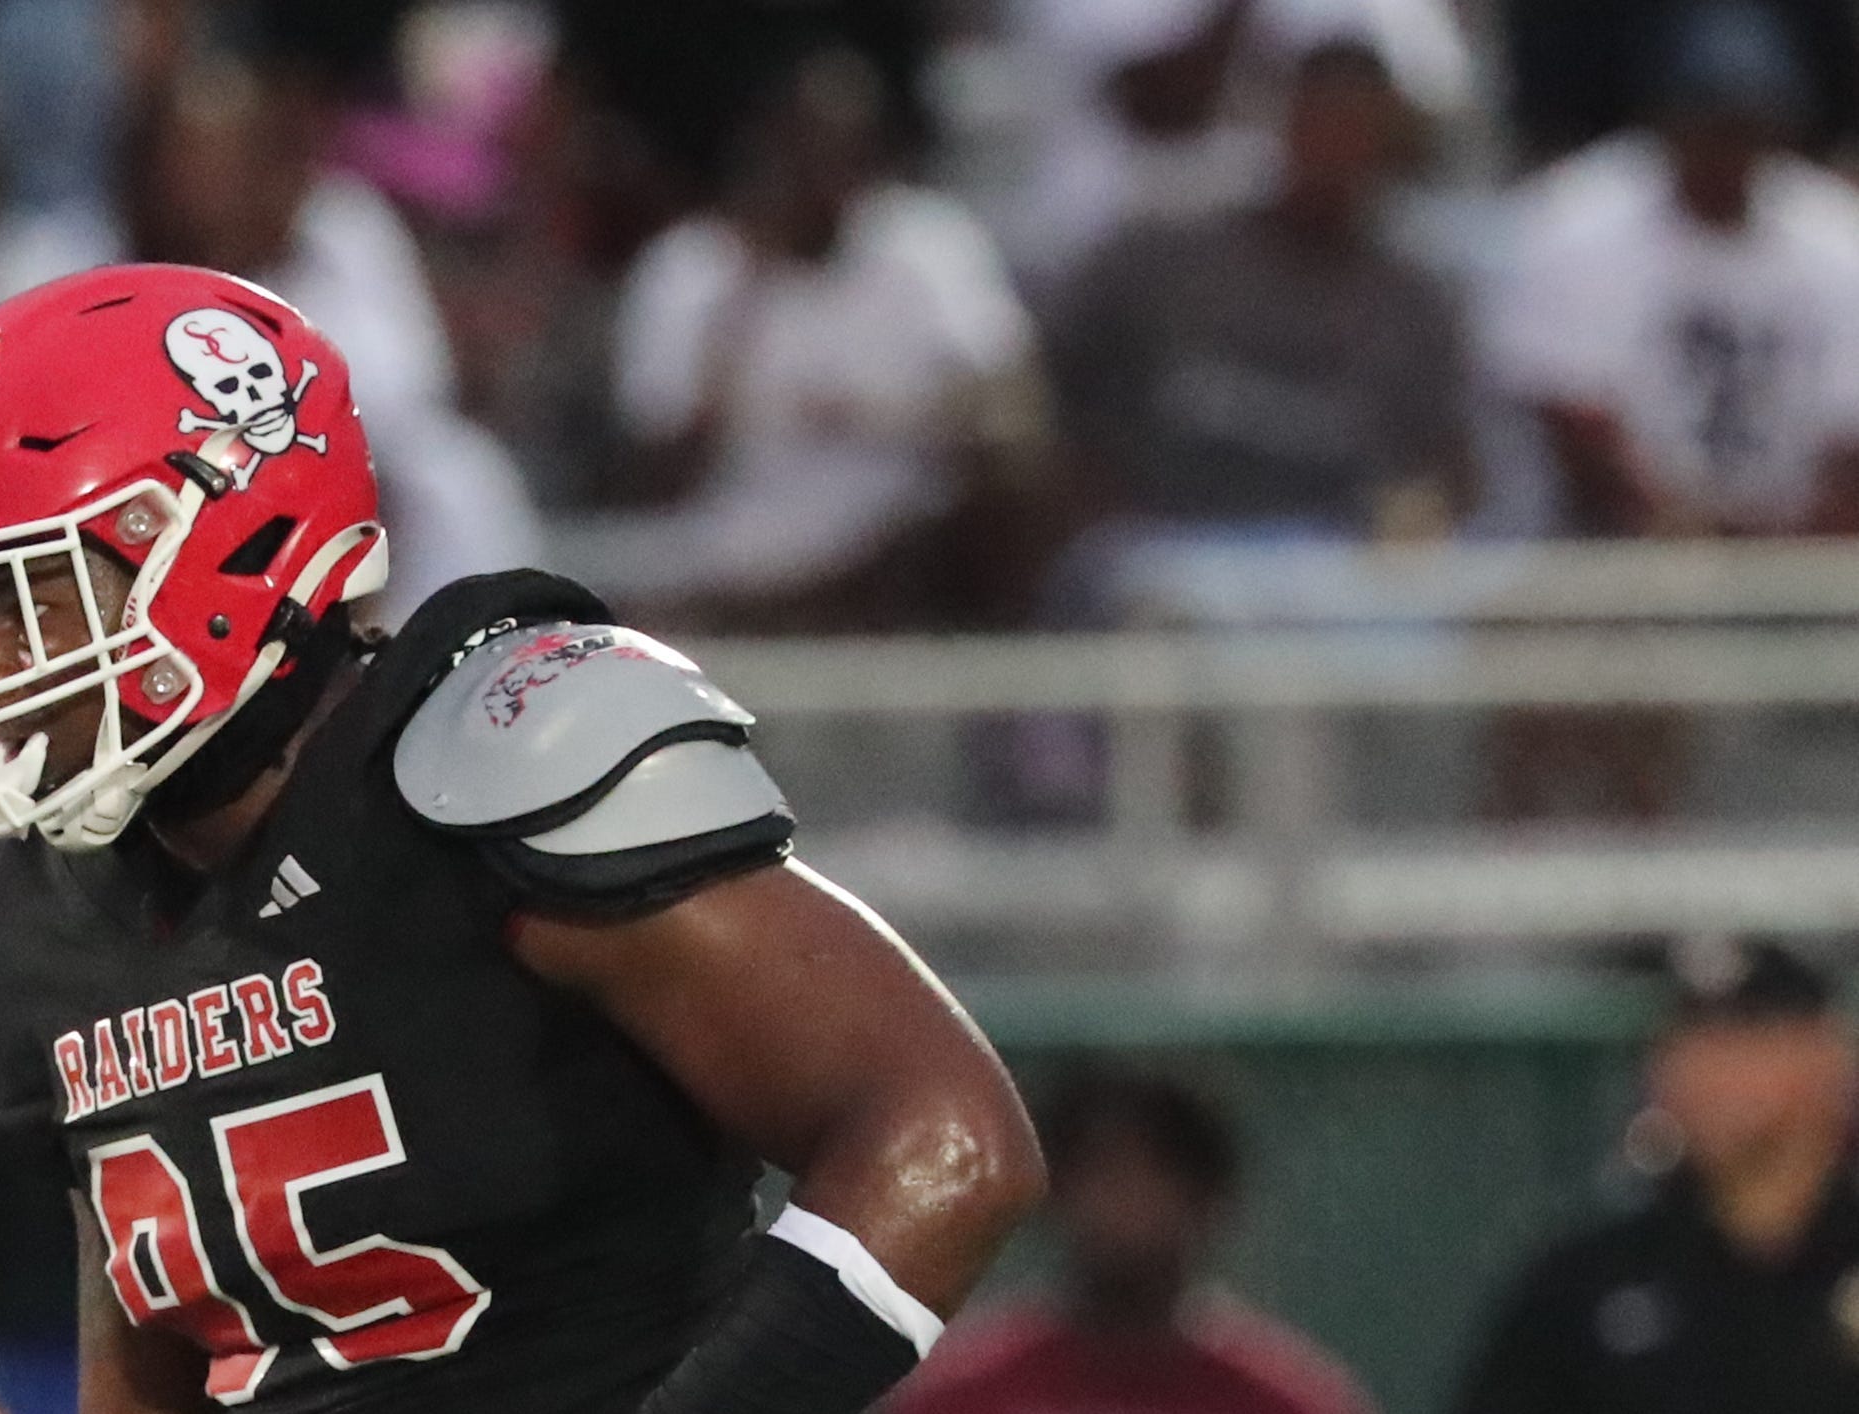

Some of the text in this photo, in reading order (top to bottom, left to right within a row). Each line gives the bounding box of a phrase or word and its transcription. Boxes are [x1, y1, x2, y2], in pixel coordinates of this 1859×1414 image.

[183, 320, 249, 364] SC
[54, 957, 336, 1122] RAIDERS
[87, 1072, 491, 1405] 95
